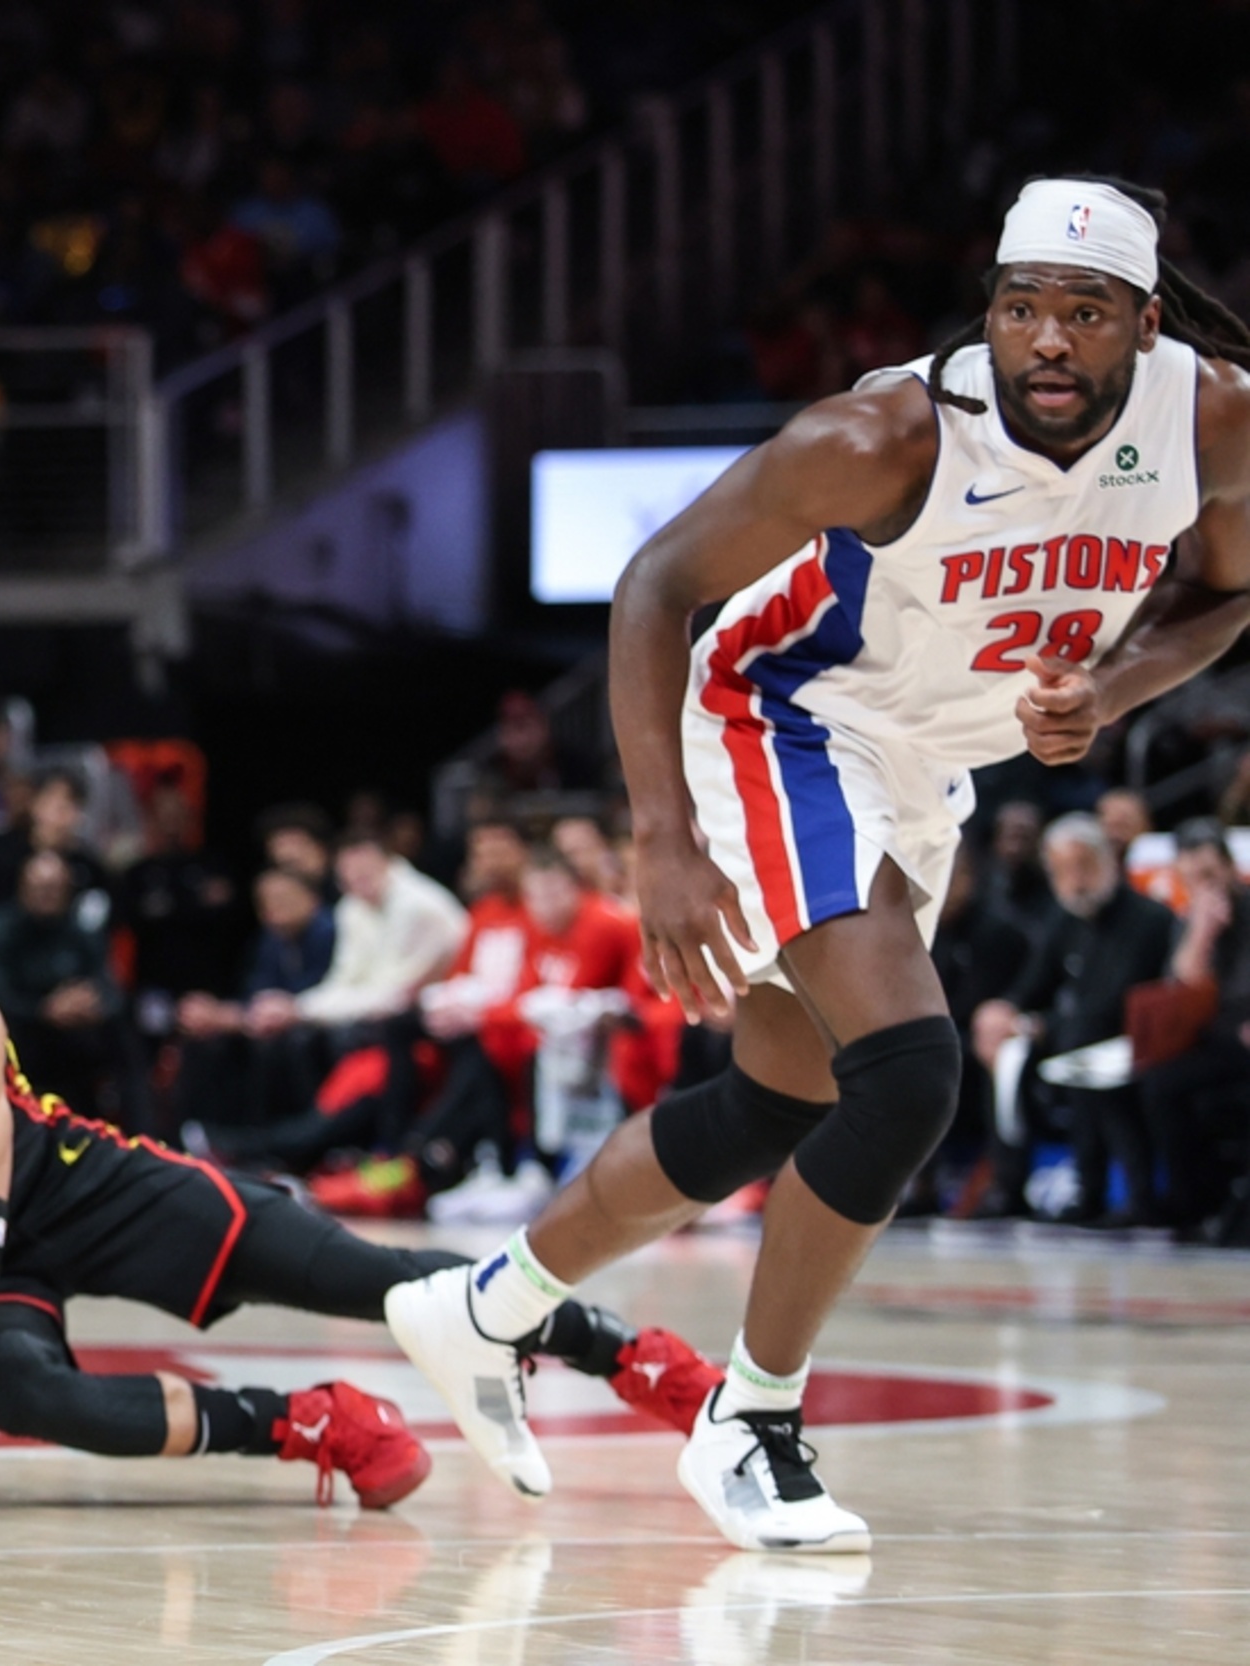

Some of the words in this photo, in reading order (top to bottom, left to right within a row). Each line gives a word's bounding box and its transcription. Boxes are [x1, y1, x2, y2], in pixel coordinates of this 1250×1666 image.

[1099, 469, 1160, 489] StockX
[940, 534, 1169, 604] PISTONS
[970, 608, 1103, 673] 28
